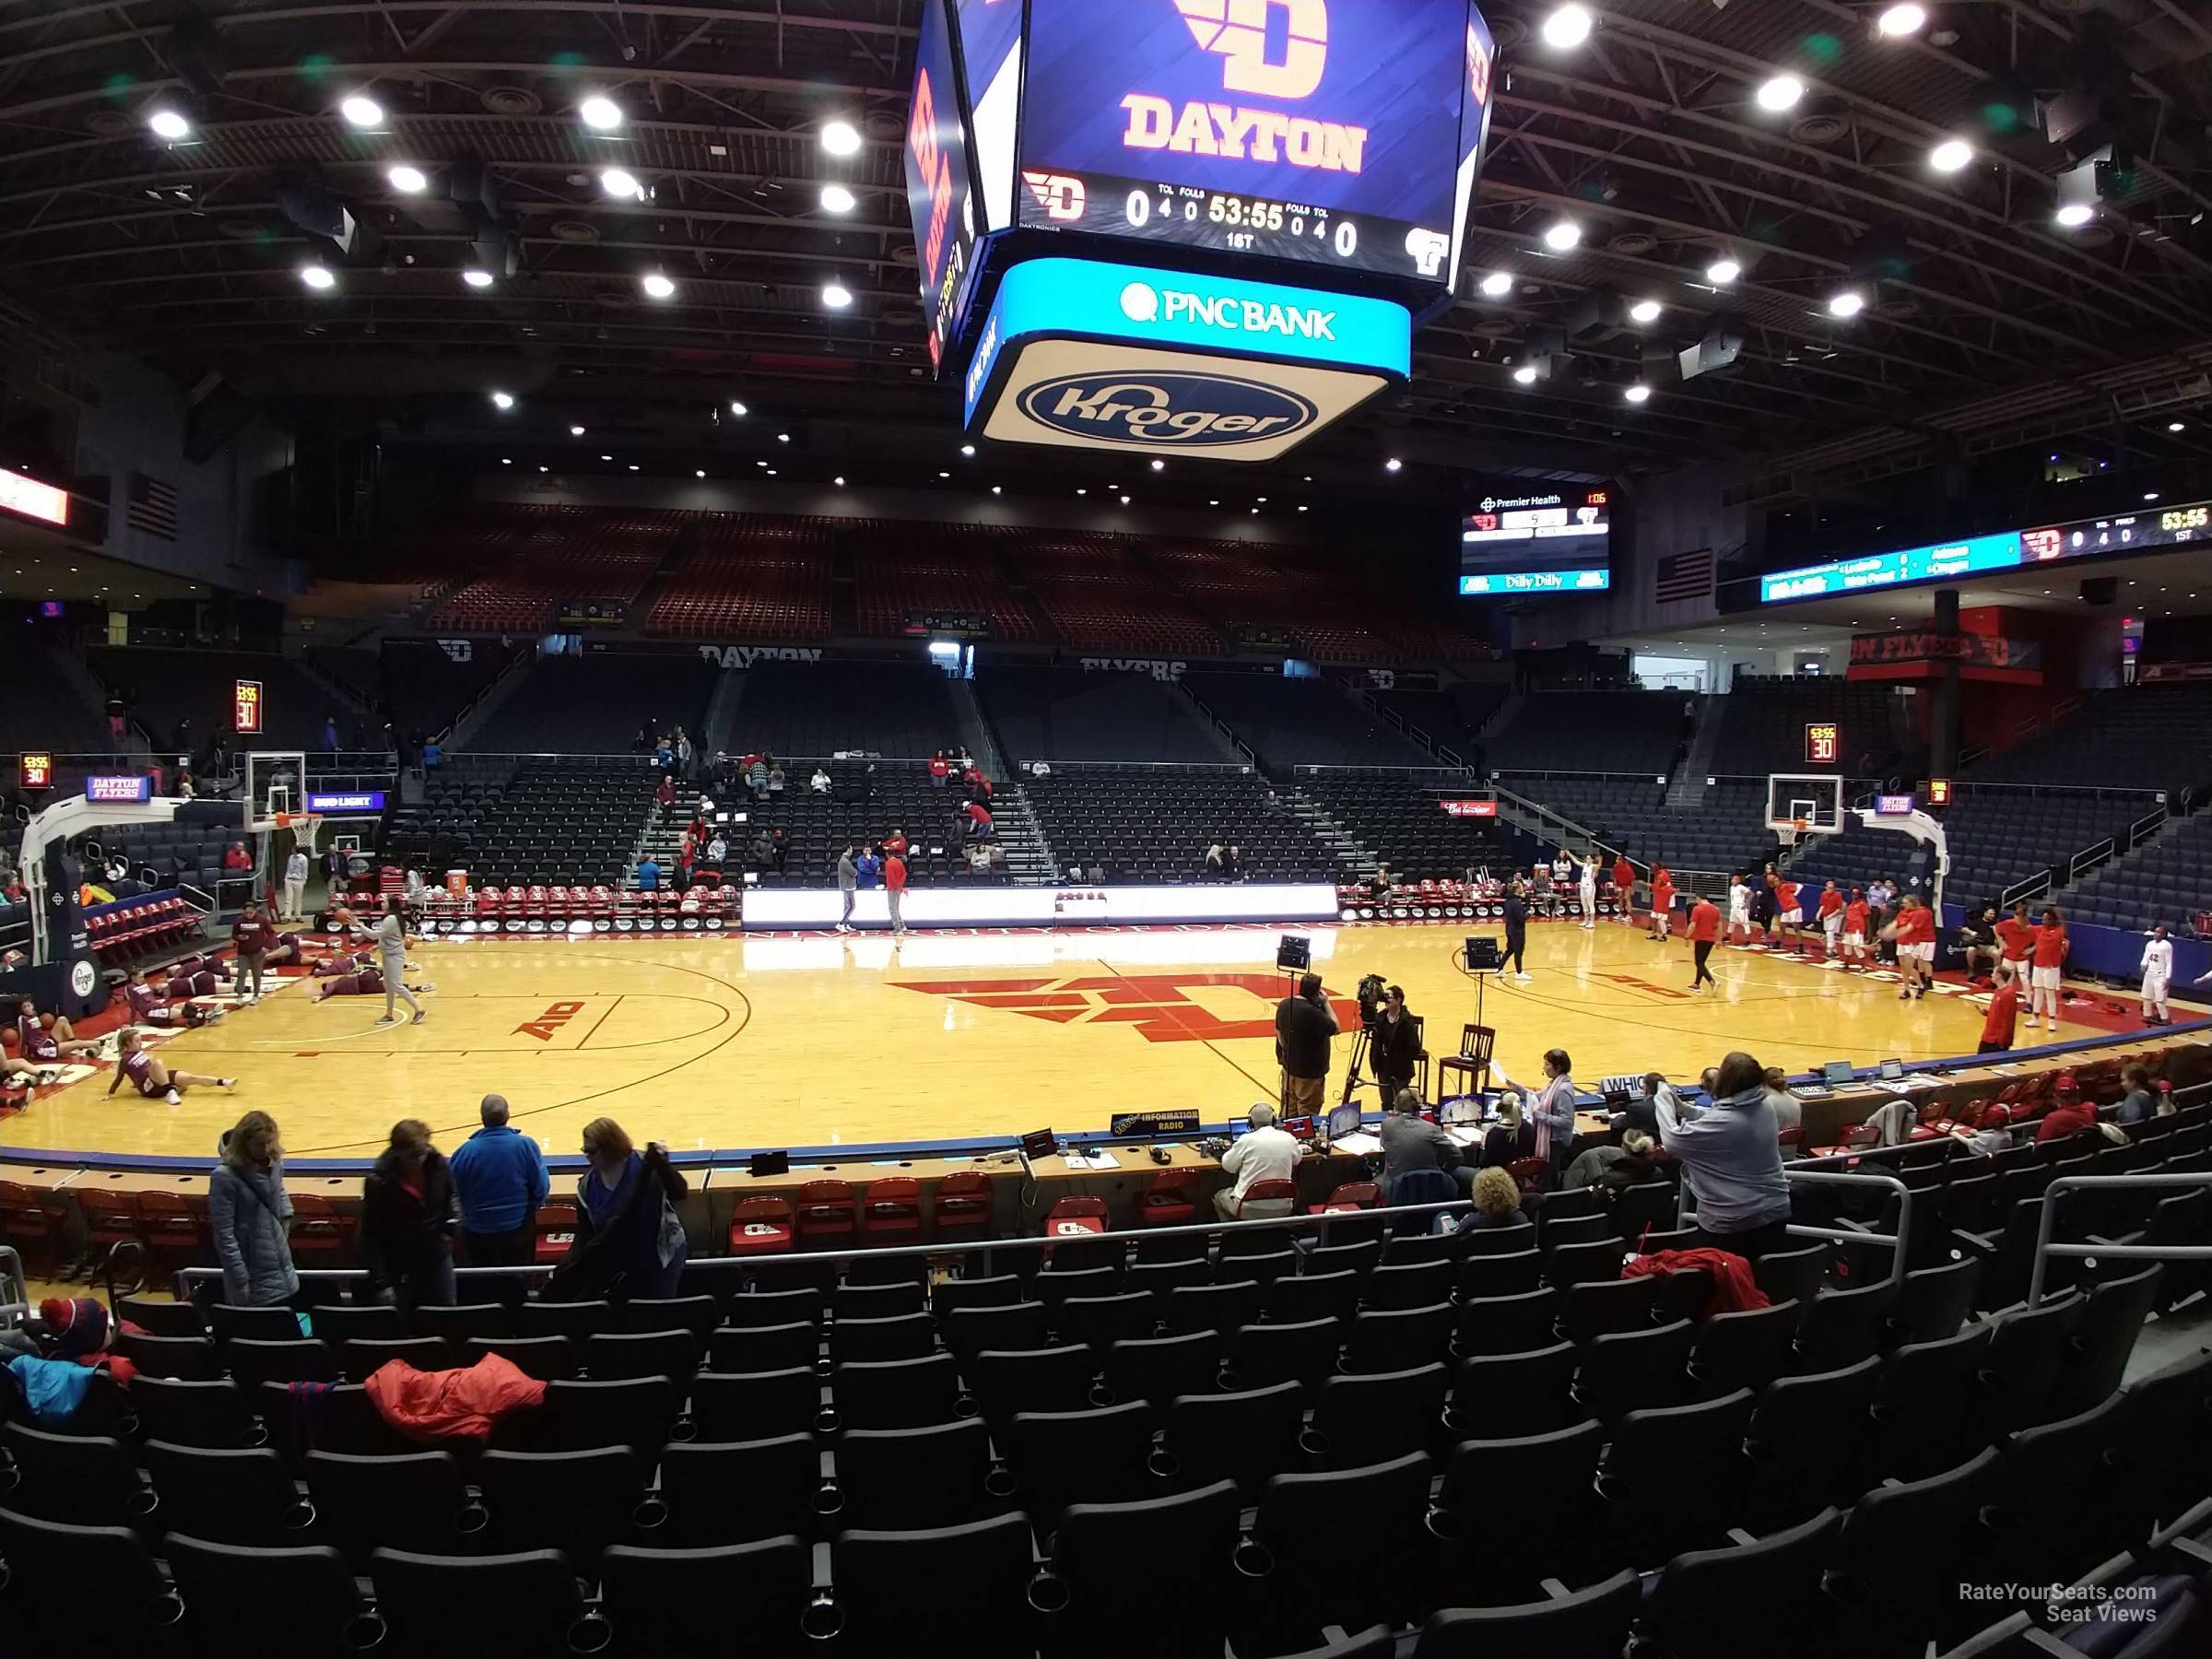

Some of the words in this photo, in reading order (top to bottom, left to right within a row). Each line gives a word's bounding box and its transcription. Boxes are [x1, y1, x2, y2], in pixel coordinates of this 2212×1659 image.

[1120, 93, 1368, 173] DAYTON
[1159, 183, 1174, 195] TOL
[1180, 187, 1205, 199] FOULS
[1126, 190, 1149, 227] 0
[1159, 198, 1171, 217] 4
[1184, 202, 1197, 221] 0
[1208, 195, 1283, 230] 53:55
[1286, 203, 1310, 215] FOULS
[1313, 207, 1329, 218] TOL
[1019, 222, 1060, 231] DAKTRONICS
[1227, 232, 1253, 249] 1ST
[1291, 217, 1303, 235] 0
[1313, 220, 1325, 239] 4
[1335, 222, 1357, 257] 0
[1161, 289, 1240, 329] PNC
[1241, 301, 1336, 341] BANK
[1053, 383, 1289, 441] Kroger
[1497, 497, 1530, 508] Premier
[1531, 495, 1560, 505] Health
[2162, 508, 2208, 531] 53:55
[2099, 532, 2109, 546] 4
[2122, 529, 2131, 542] 0
[2175, 531, 2193, 542] 1ST
[1881, 634, 1972, 659] FLYES
[239, 702, 253, 727] 30
[1810, 727, 1835, 739] 53:55
[1814, 739, 1832, 759] 30
[28, 769, 43, 782] 30
[93, 778, 141, 788] DAYTON
[94, 788, 139, 797] FLYERS
[2148, 953, 2159, 962] 42
[75, 968, 92, 992] Kroger
[1142, 1110, 1198, 1122] INFORMATION
[1159, 1121, 1184, 1131] RADIO
